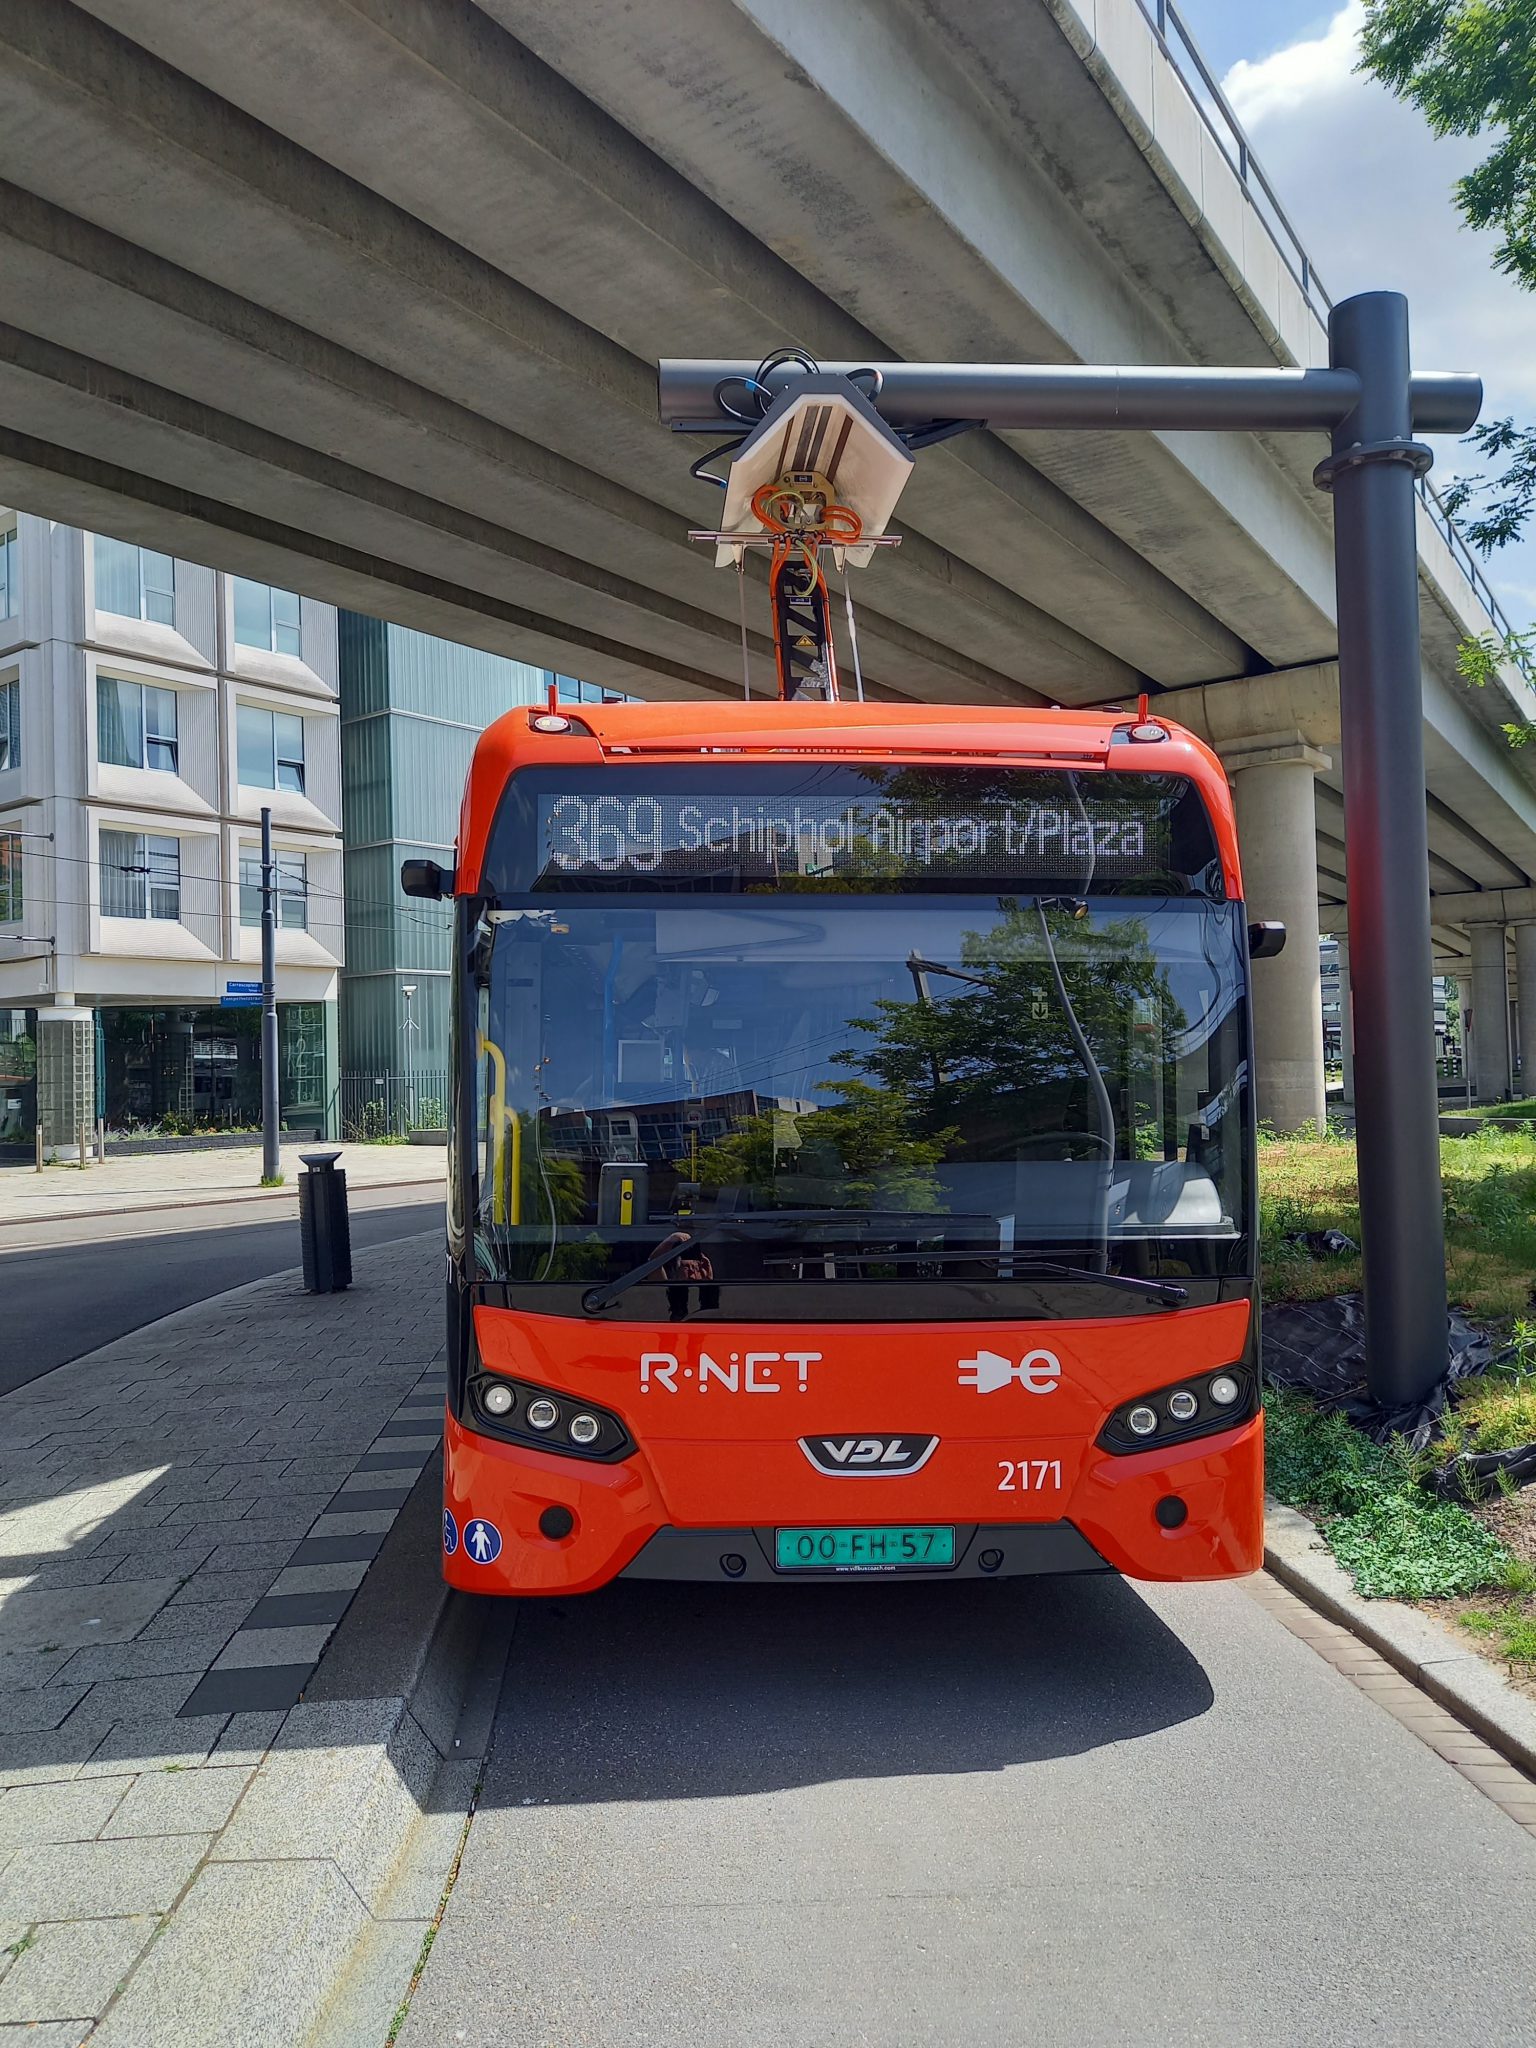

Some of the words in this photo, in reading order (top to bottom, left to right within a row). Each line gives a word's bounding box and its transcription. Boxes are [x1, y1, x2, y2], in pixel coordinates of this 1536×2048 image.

[553, 795, 662, 871] 369
[678, 805, 855, 864] Schiphol
[821, 1439, 913, 1463] VDL
[998, 1460, 1062, 1491] 2171
[797, 1533, 936, 1560] 00-FH-57
